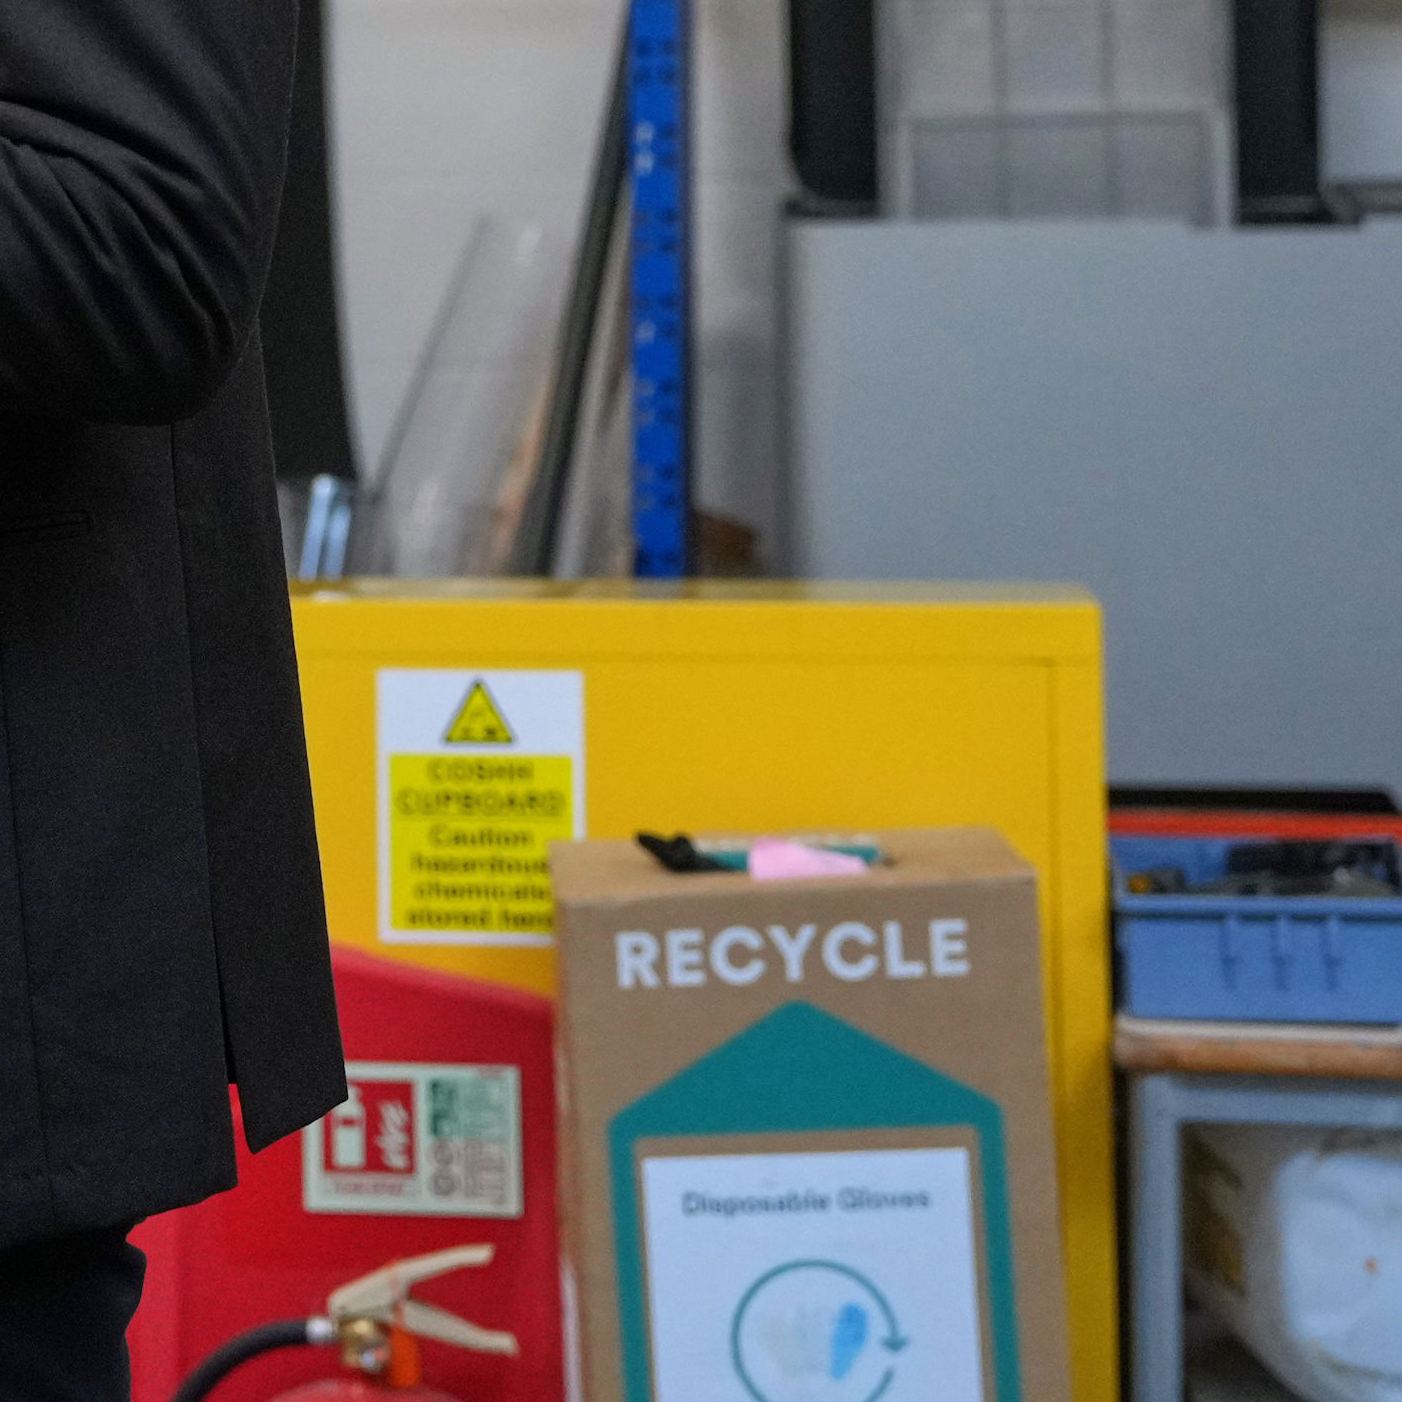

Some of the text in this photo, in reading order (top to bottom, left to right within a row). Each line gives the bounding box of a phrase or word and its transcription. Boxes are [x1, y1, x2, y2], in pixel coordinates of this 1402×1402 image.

[427, 758, 535, 783] COSHH
[397, 787, 567, 816] CUPBOARD
[427, 823, 535, 847] Caution
[405, 907, 493, 928] stored
[614, 918, 971, 990] RECYCLE
[682, 1186, 933, 1218] Disposable Gloves
